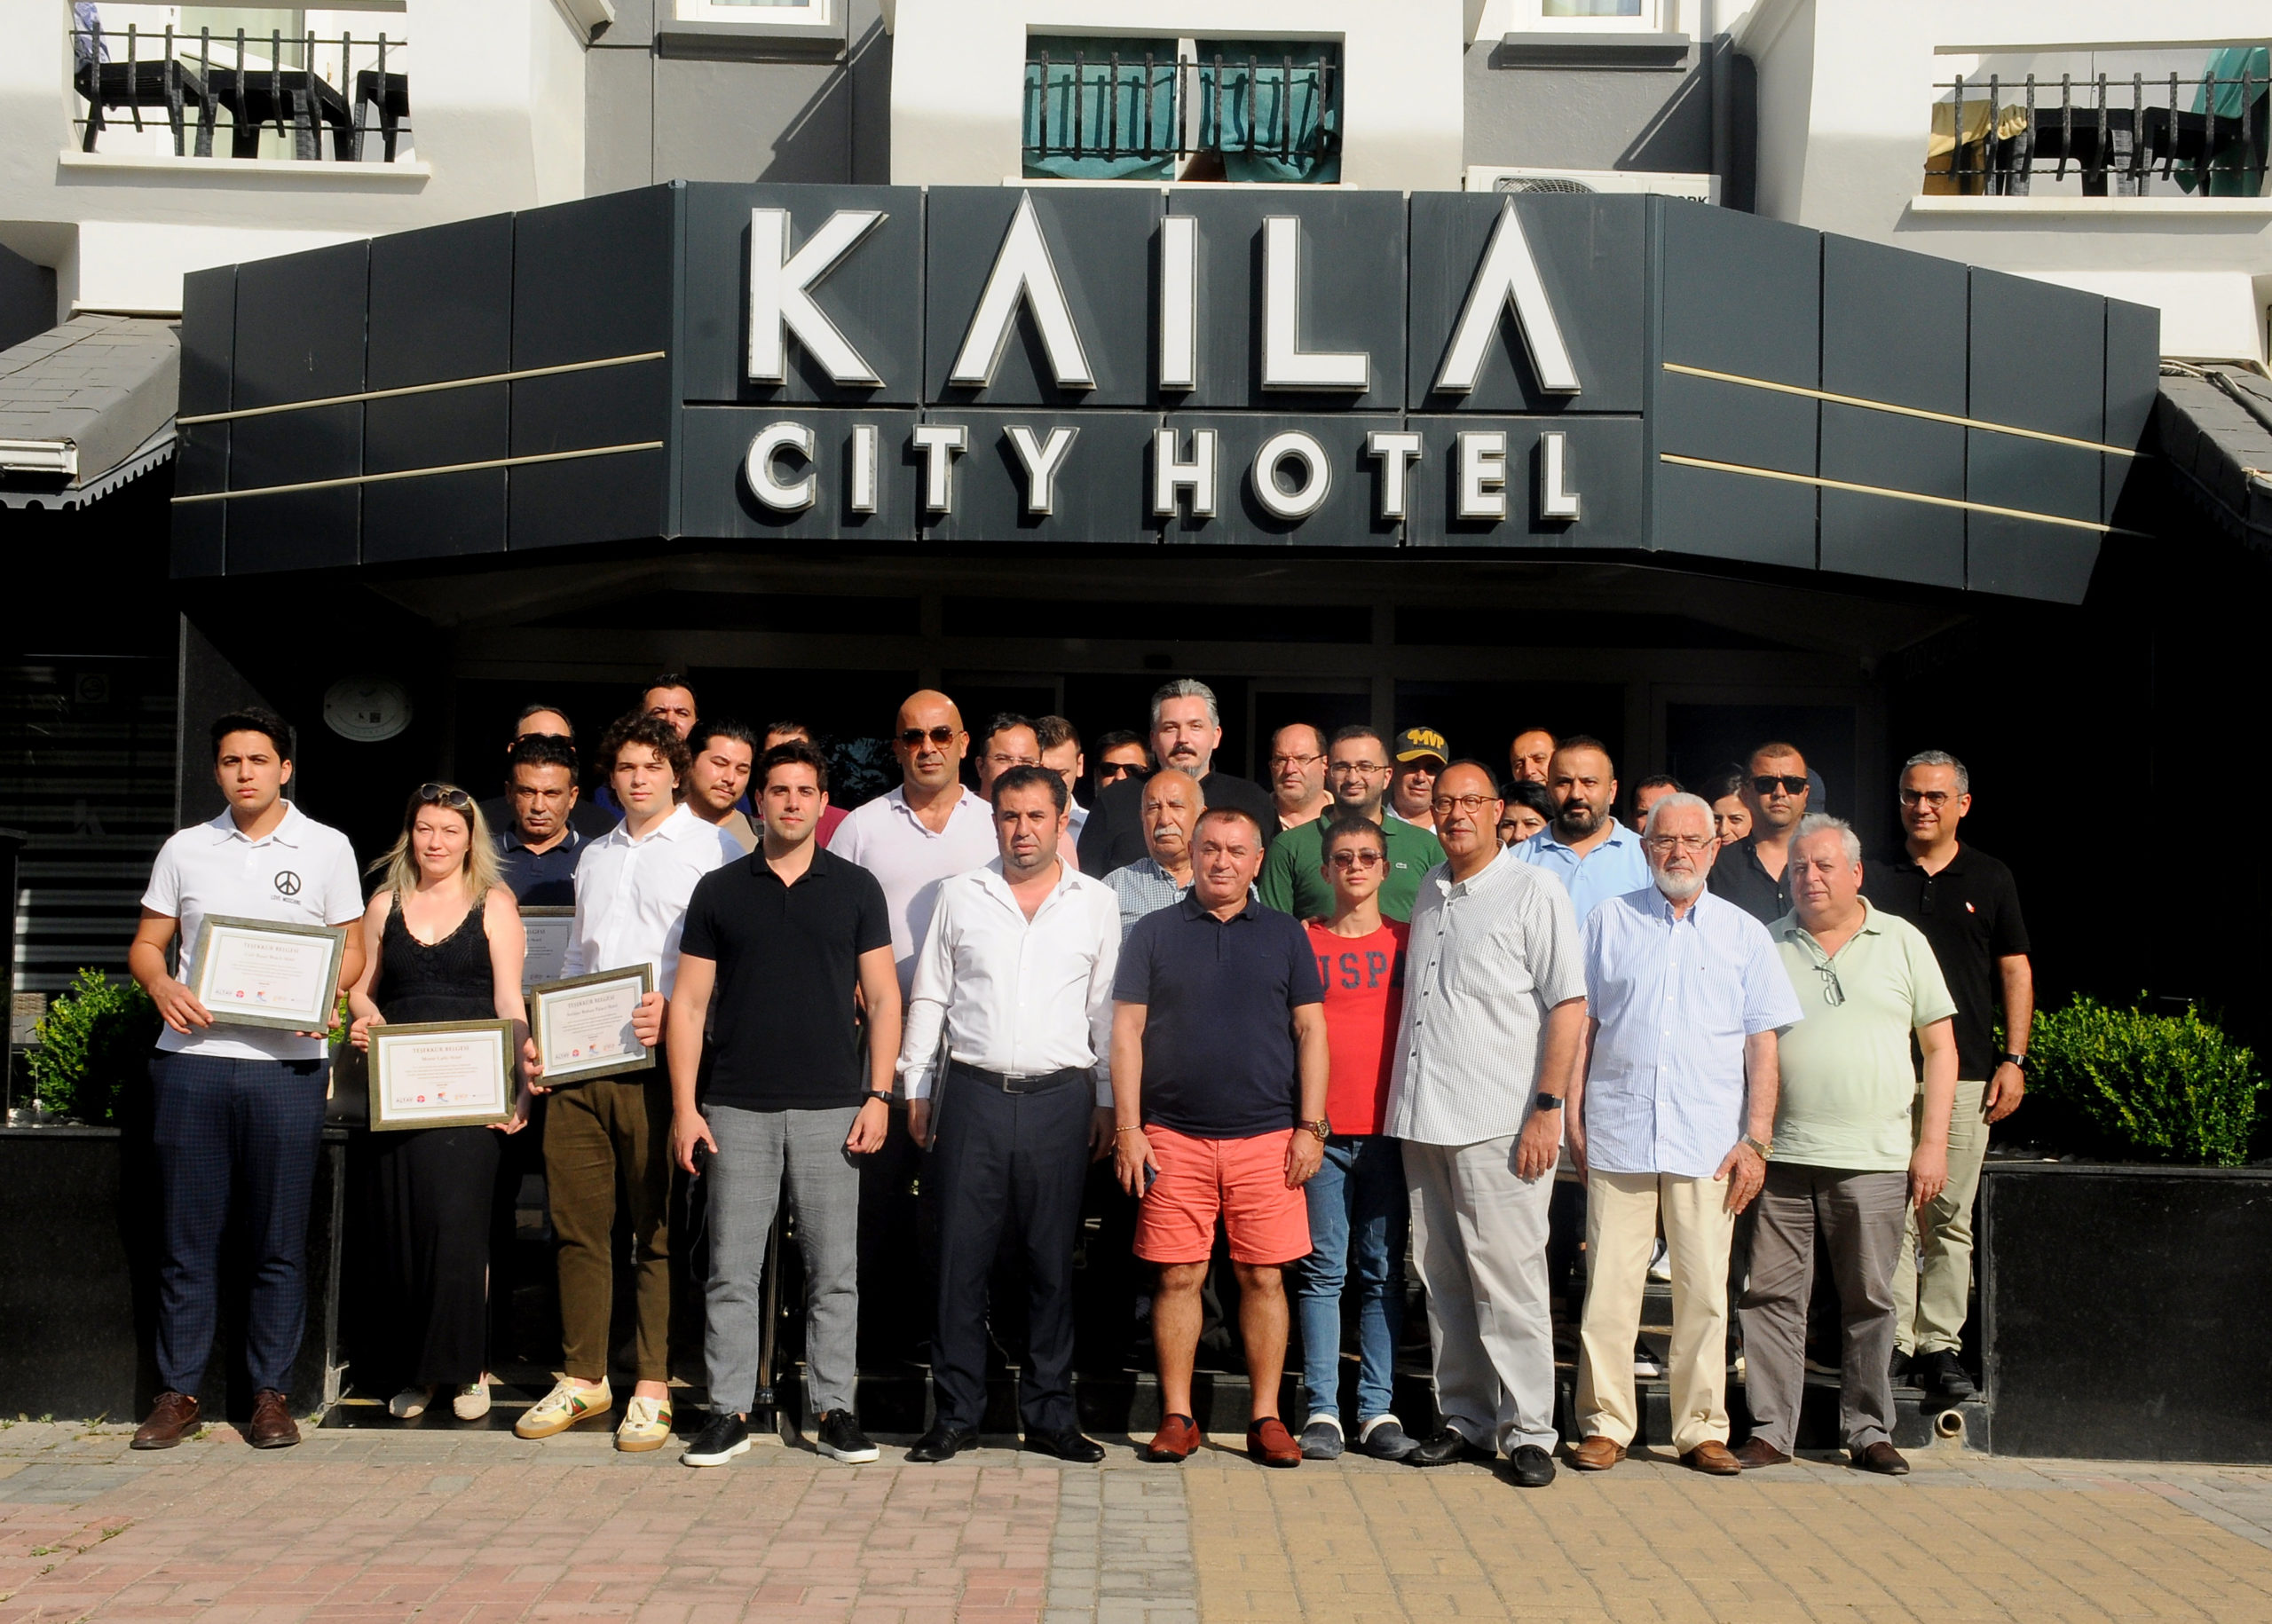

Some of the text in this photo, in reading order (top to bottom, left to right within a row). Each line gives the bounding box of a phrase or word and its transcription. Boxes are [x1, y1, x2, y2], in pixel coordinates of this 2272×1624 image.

[747, 190, 1582, 395] KAILA
[746, 422, 1581, 521] CITY HOTEL
